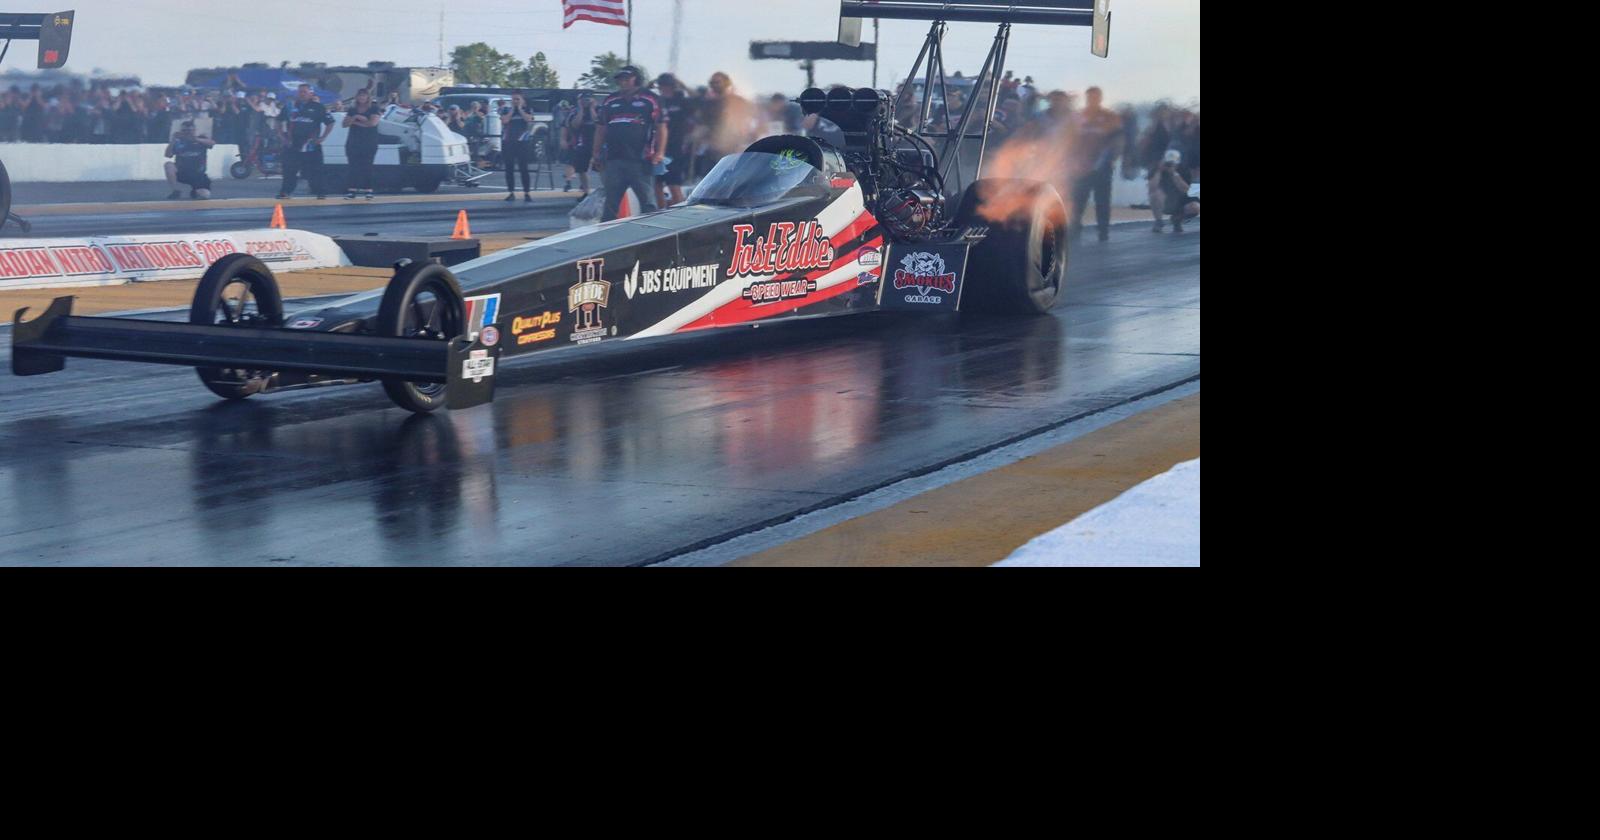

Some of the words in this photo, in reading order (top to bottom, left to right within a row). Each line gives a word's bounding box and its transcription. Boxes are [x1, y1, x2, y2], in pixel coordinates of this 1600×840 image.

[0, 248, 60, 277] ADIAN
[53, 246, 114, 273] NITRO
[109, 242, 202, 269] NATIONALS
[727, 223, 778, 276] Fast
[775, 220, 831, 270] Eddie
[639, 269, 662, 295] JBS
[663, 263, 720, 293] EQUIPMENT
[751, 282, 781, 301] SPEED
[781, 279, 808, 298] WEAR
[894, 269, 956, 294] SMOKIES
[573, 284, 605, 305] HYDE
[904, 295, 943, 304] GARAGE
